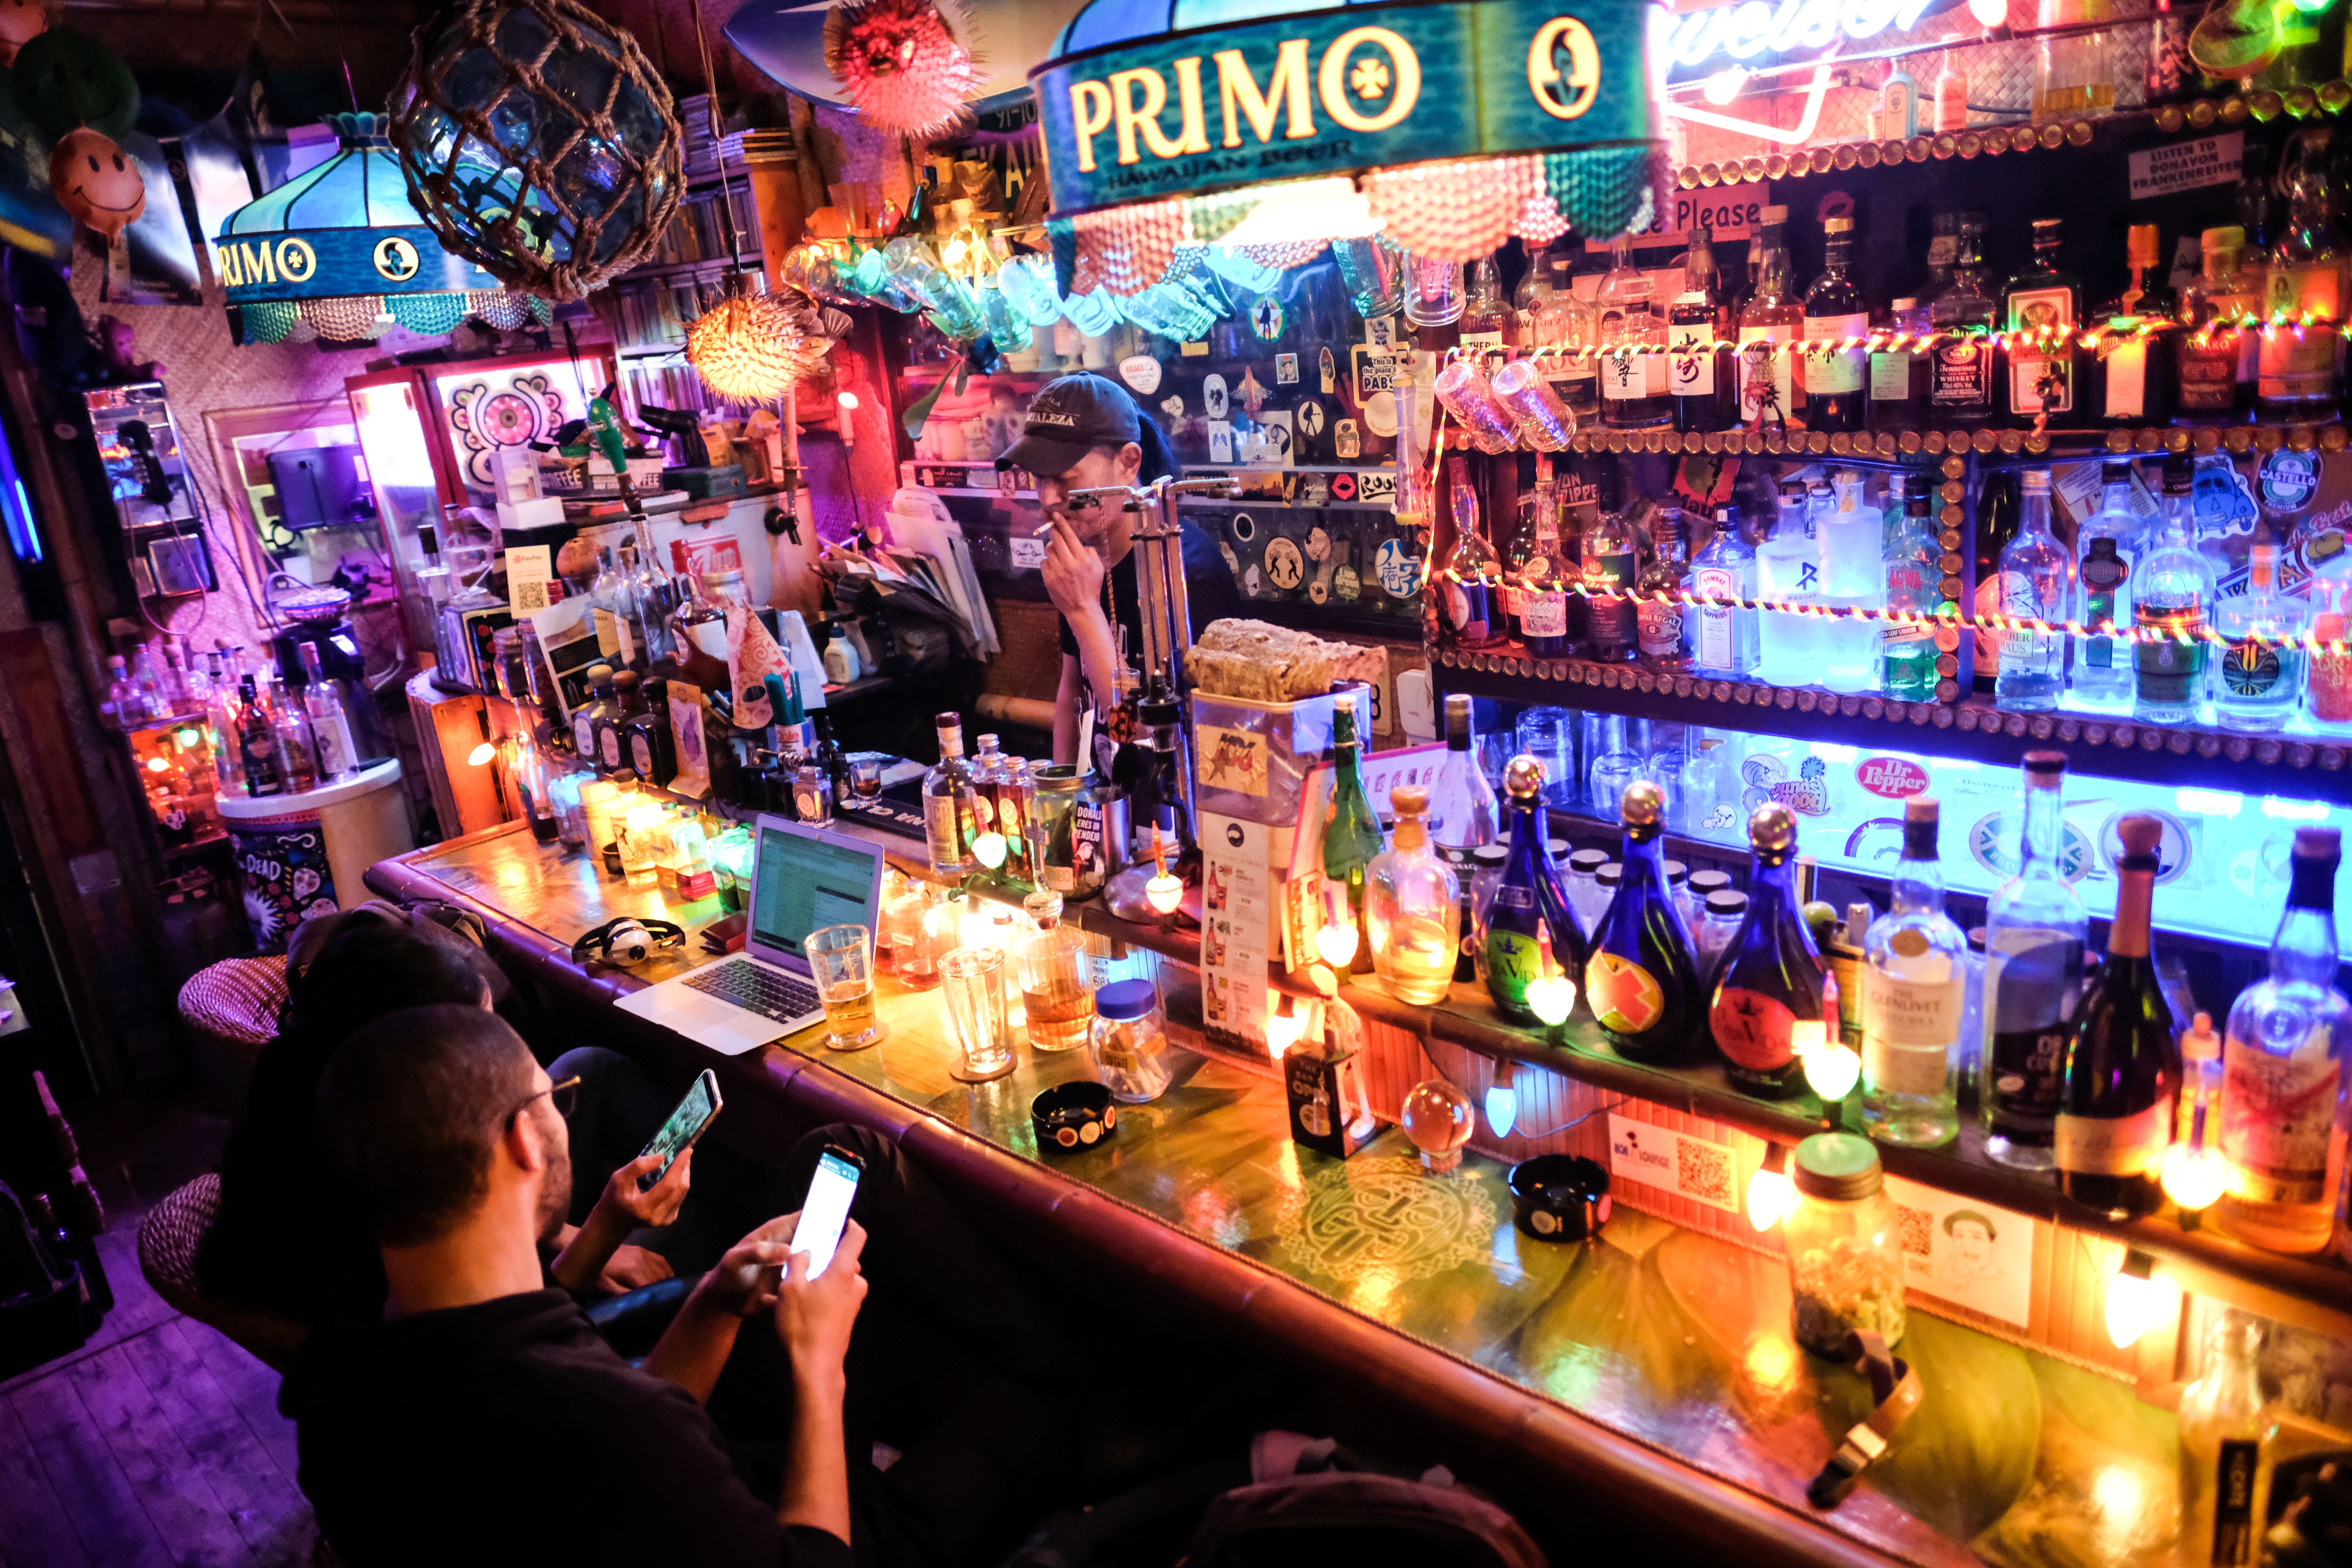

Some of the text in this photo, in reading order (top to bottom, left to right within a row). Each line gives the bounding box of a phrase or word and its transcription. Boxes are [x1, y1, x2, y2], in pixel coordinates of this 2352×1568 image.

[1069, 26, 1421, 172] PRIMO
[2150, 141, 2217, 162] LISTEN TO
[1109, 138, 1352, 190] HAWAIIAN BEER
[2148, 152, 2219, 175] DONAVON
[1677, 198, 1760, 230] Please
[1363, 366, 1374, 374] the
[2259, 469, 2317, 487] CASTELLO
[1339, 567, 1355, 578] Live
[1703, 574, 1726, 586] BOMBAY
[1591, 599, 1601, 610] 12
[1653, 614, 1677, 626] REGAL
[1702, 608, 1728, 620] SAPPHIRE
[1899, 626, 1916, 635] LIQUEUR
[1885, 759, 1912, 779] Dr
[1863, 766, 1926, 794] Pepper
[1077, 806, 1102, 821] DONALD
[1077, 818, 1100, 831] ERES UN
[246, 854, 281, 881] DEAD
[1868, 991, 1940, 1013] GLENLIVET
